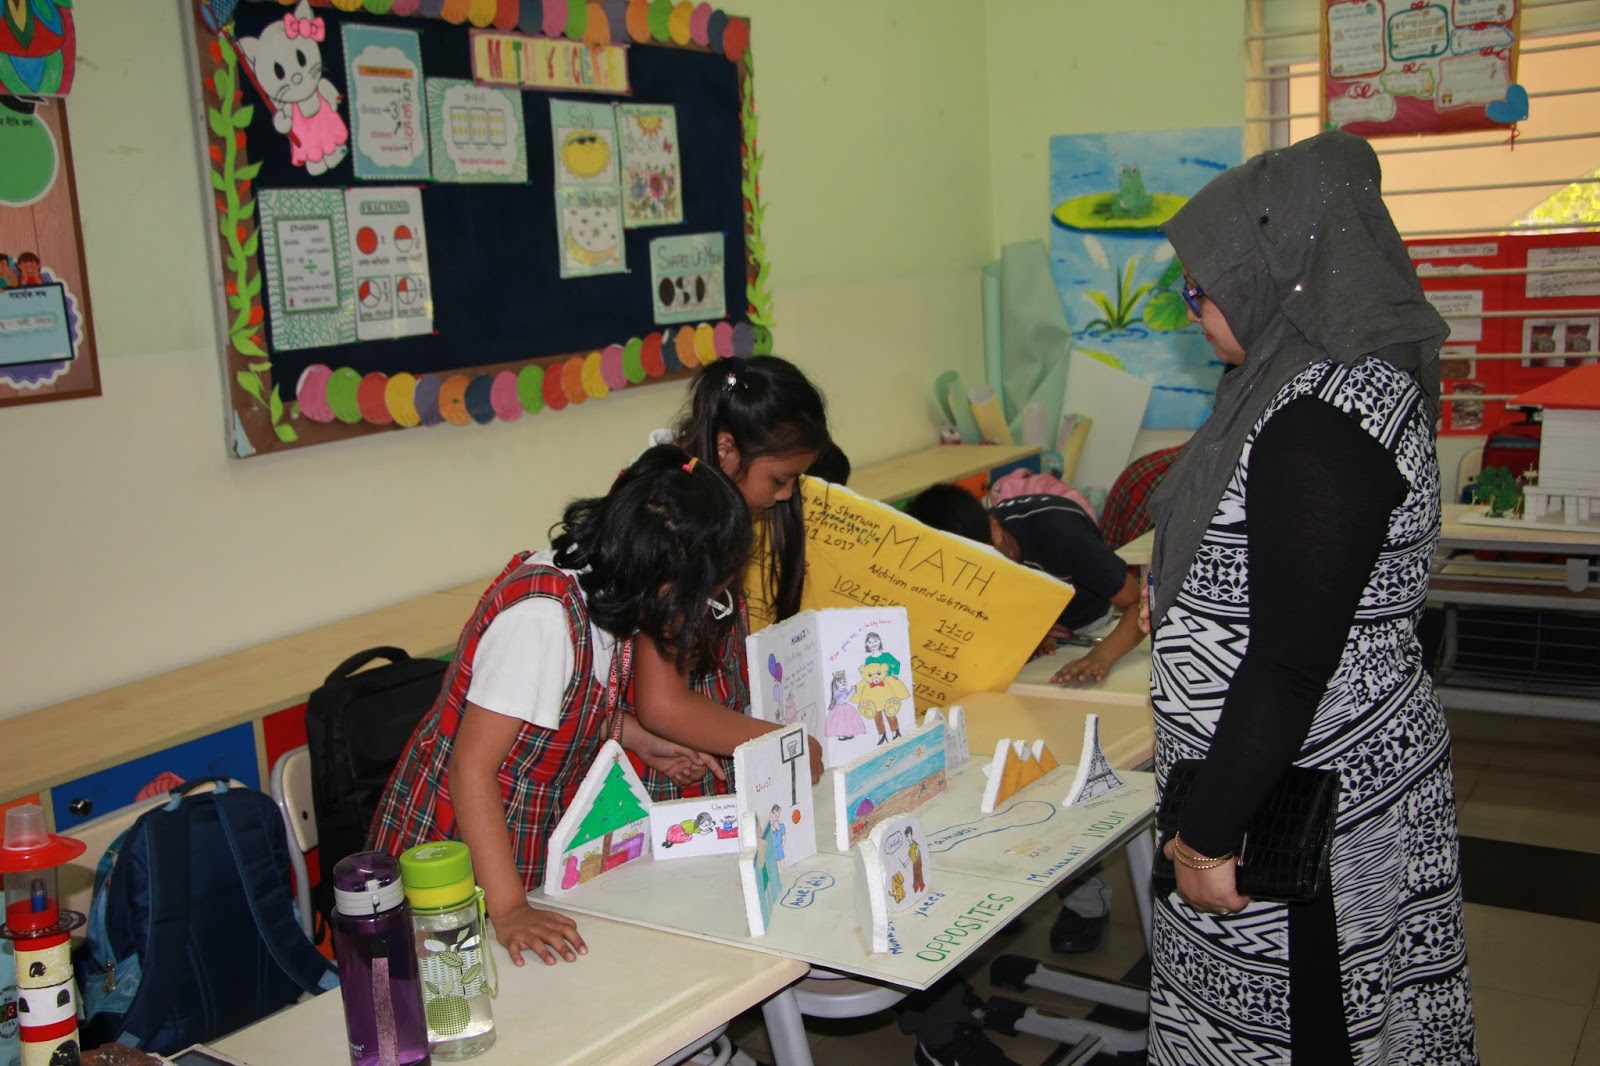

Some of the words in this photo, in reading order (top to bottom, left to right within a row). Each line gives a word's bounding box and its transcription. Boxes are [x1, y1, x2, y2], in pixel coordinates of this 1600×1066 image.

[871, 525, 996, 597] MATH
[910, 584, 935, 600] and
[608, 686, 616, 707] HOPE
[1082, 811, 1129, 839] NOUN
[916, 893, 1014, 964] OPPOSITES
